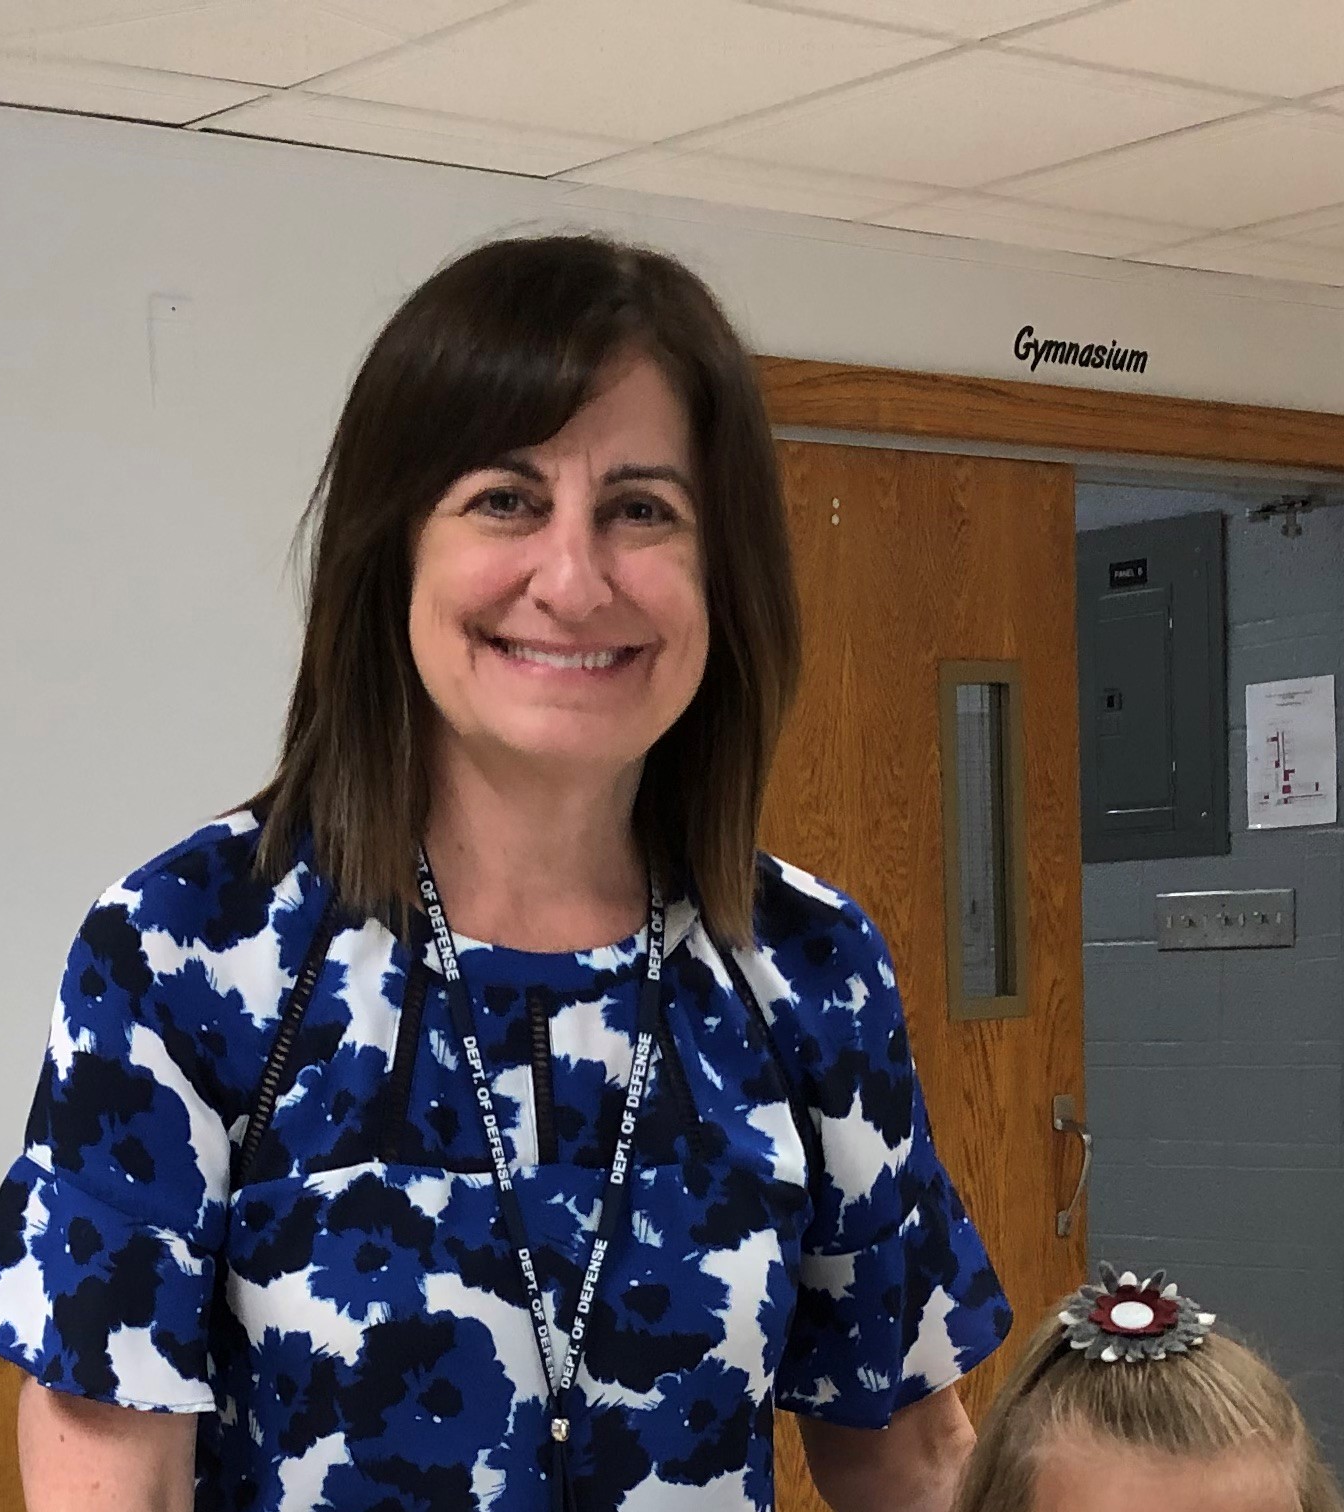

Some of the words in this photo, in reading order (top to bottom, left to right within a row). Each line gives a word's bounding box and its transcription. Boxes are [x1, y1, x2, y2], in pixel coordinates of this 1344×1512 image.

[1013, 325, 1149, 374] Gymnasium
[421, 880, 438, 901] OF
[428, 904, 460, 982] DEFENSE
[651, 911, 663, 933] OF
[462, 1035, 485, 1086] DEPT.
[626, 1032, 653, 1109] DEFENSE
[476, 1086, 493, 1112] OF
[621, 1110, 639, 1136] OF
[483, 1112, 513, 1192] DEFENSE
[610, 1137, 633, 1186] DEPT.
[518, 1247, 539, 1296] DEPT.
[576, 1238, 608, 1315] DEFENSE
[531, 1298, 545, 1321] OF
[571, 1316, 586, 1340] OF
[537, 1324, 557, 1390] DEFEN
[560, 1344, 581, 1390] DEPT.
